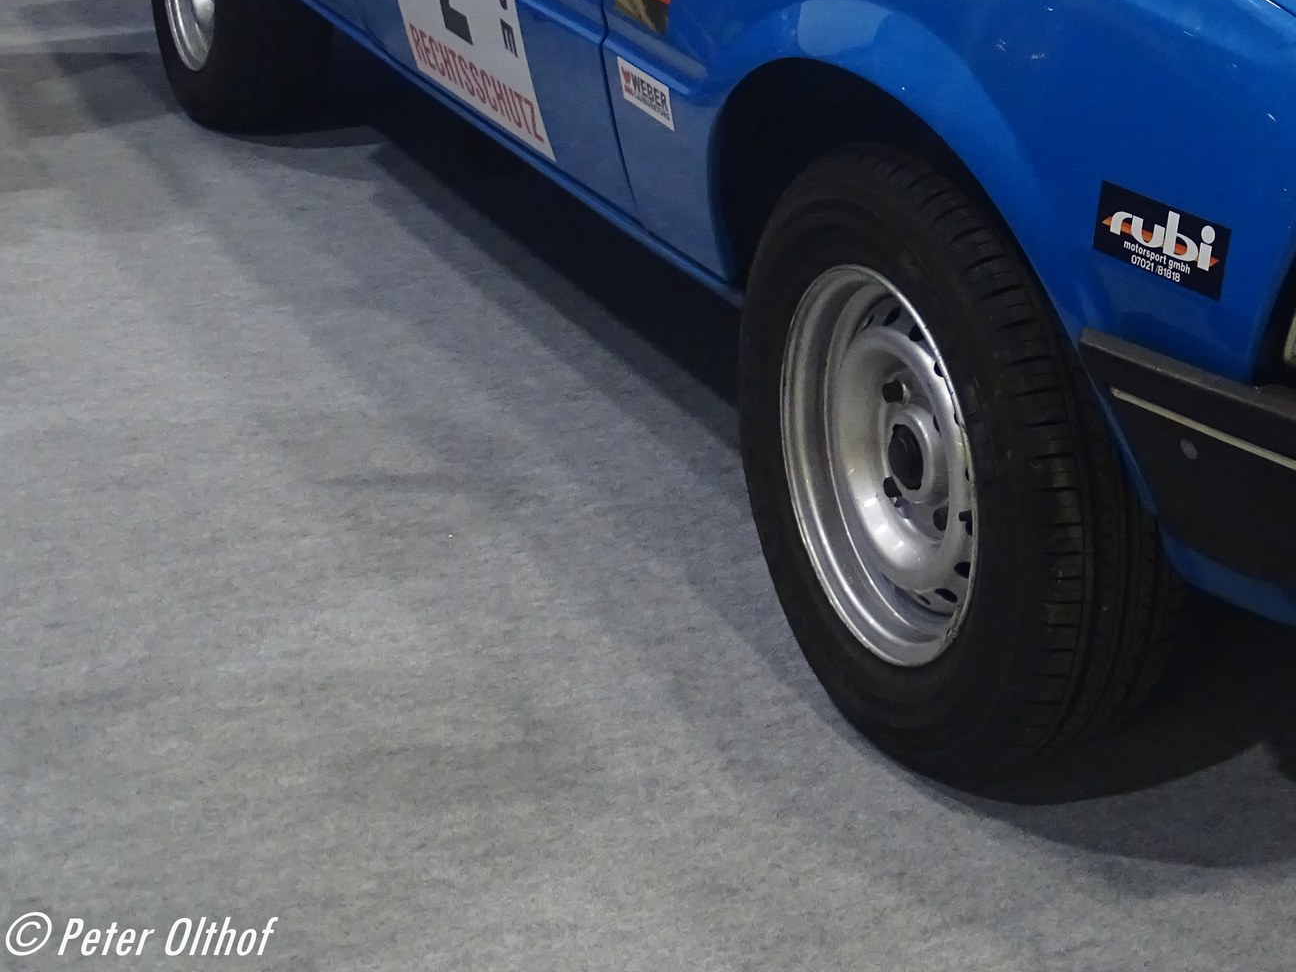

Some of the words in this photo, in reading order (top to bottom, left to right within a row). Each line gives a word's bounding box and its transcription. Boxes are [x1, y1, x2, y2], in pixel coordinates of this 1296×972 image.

[409, 23, 545, 142] RECHTSSCHUTZ
[631, 73, 669, 111] WEBER
[1109, 210, 1216, 272] rubi
[1123, 240, 1167, 264] motorsport
[1168, 259, 1191, 275] gmbh
[1131, 255, 1154, 272] 07021
[1155, 265, 1181, 283] /81818
